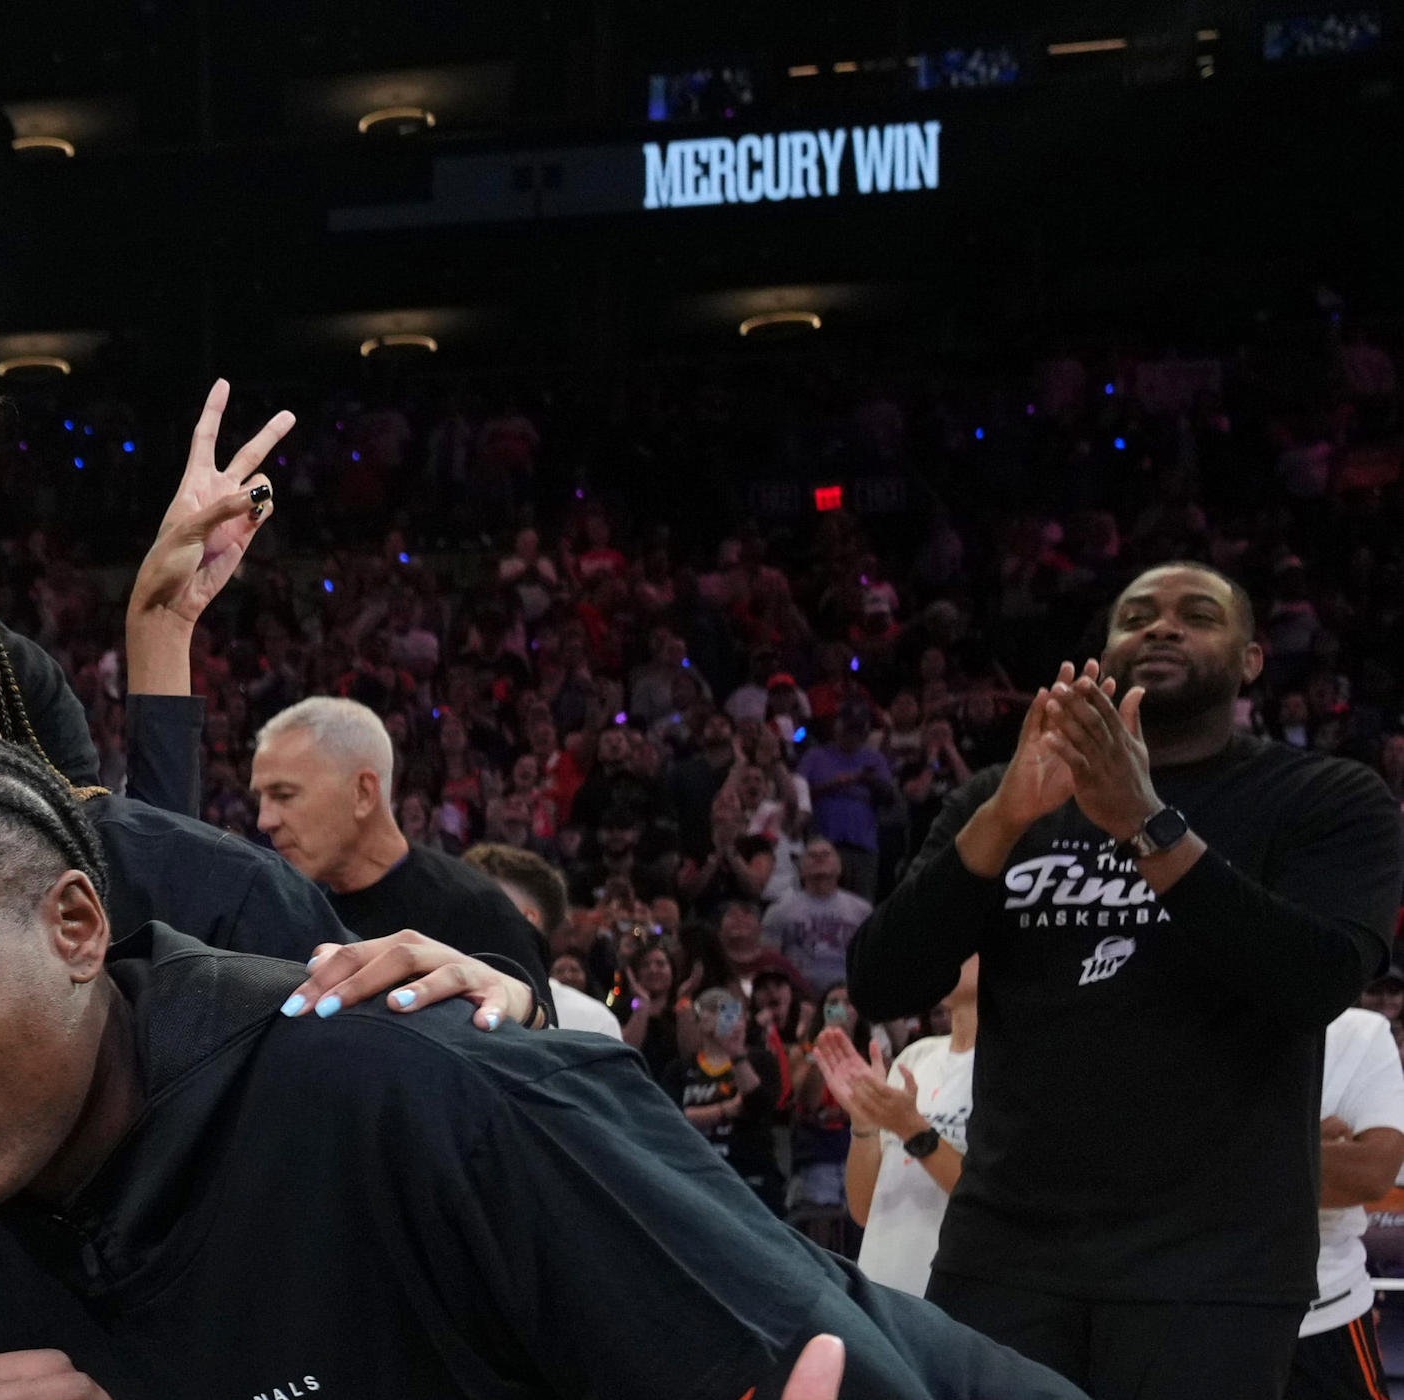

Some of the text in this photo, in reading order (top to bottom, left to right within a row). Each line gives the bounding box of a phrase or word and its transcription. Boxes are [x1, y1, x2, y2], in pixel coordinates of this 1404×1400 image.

[643, 120, 941, 209] MERCURY WIN
[1004, 854, 1156, 910] Fina
[1019, 907, 1171, 929] BASKETBA
